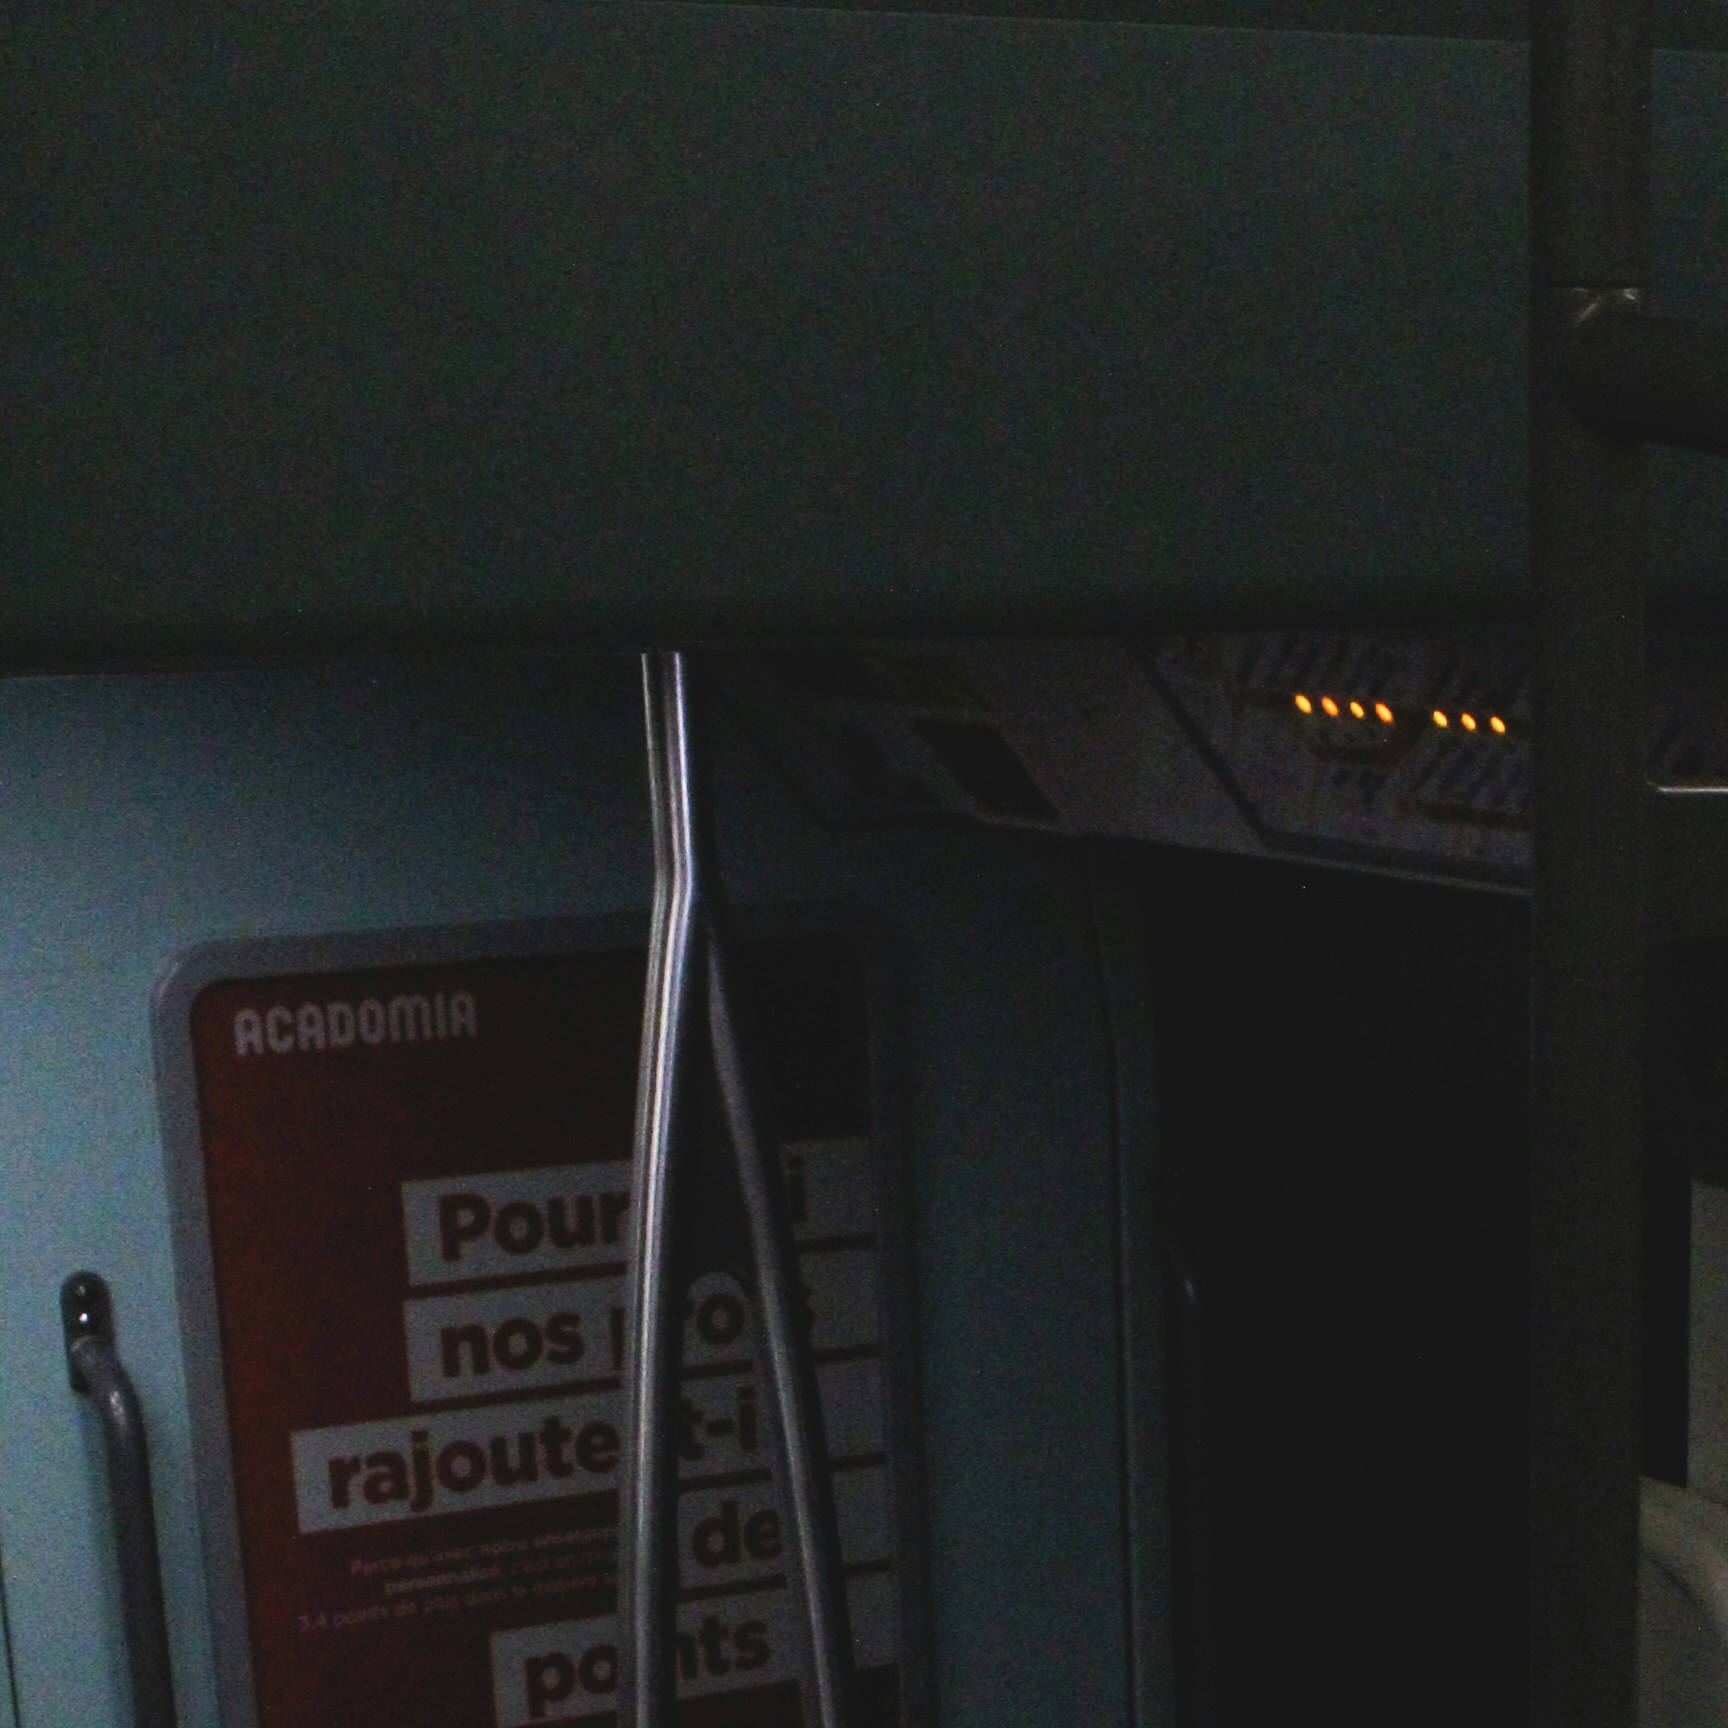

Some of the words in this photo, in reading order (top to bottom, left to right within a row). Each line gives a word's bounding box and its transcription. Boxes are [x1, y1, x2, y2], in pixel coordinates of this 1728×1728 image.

[233, 988, 479, 1056] ACADOMIA
[438, 1189, 632, 1262] Pour
[440, 1311, 587, 1378] nos
[692, 1500, 783, 1569] de
[525, 1614, 771, 1719] ponts
